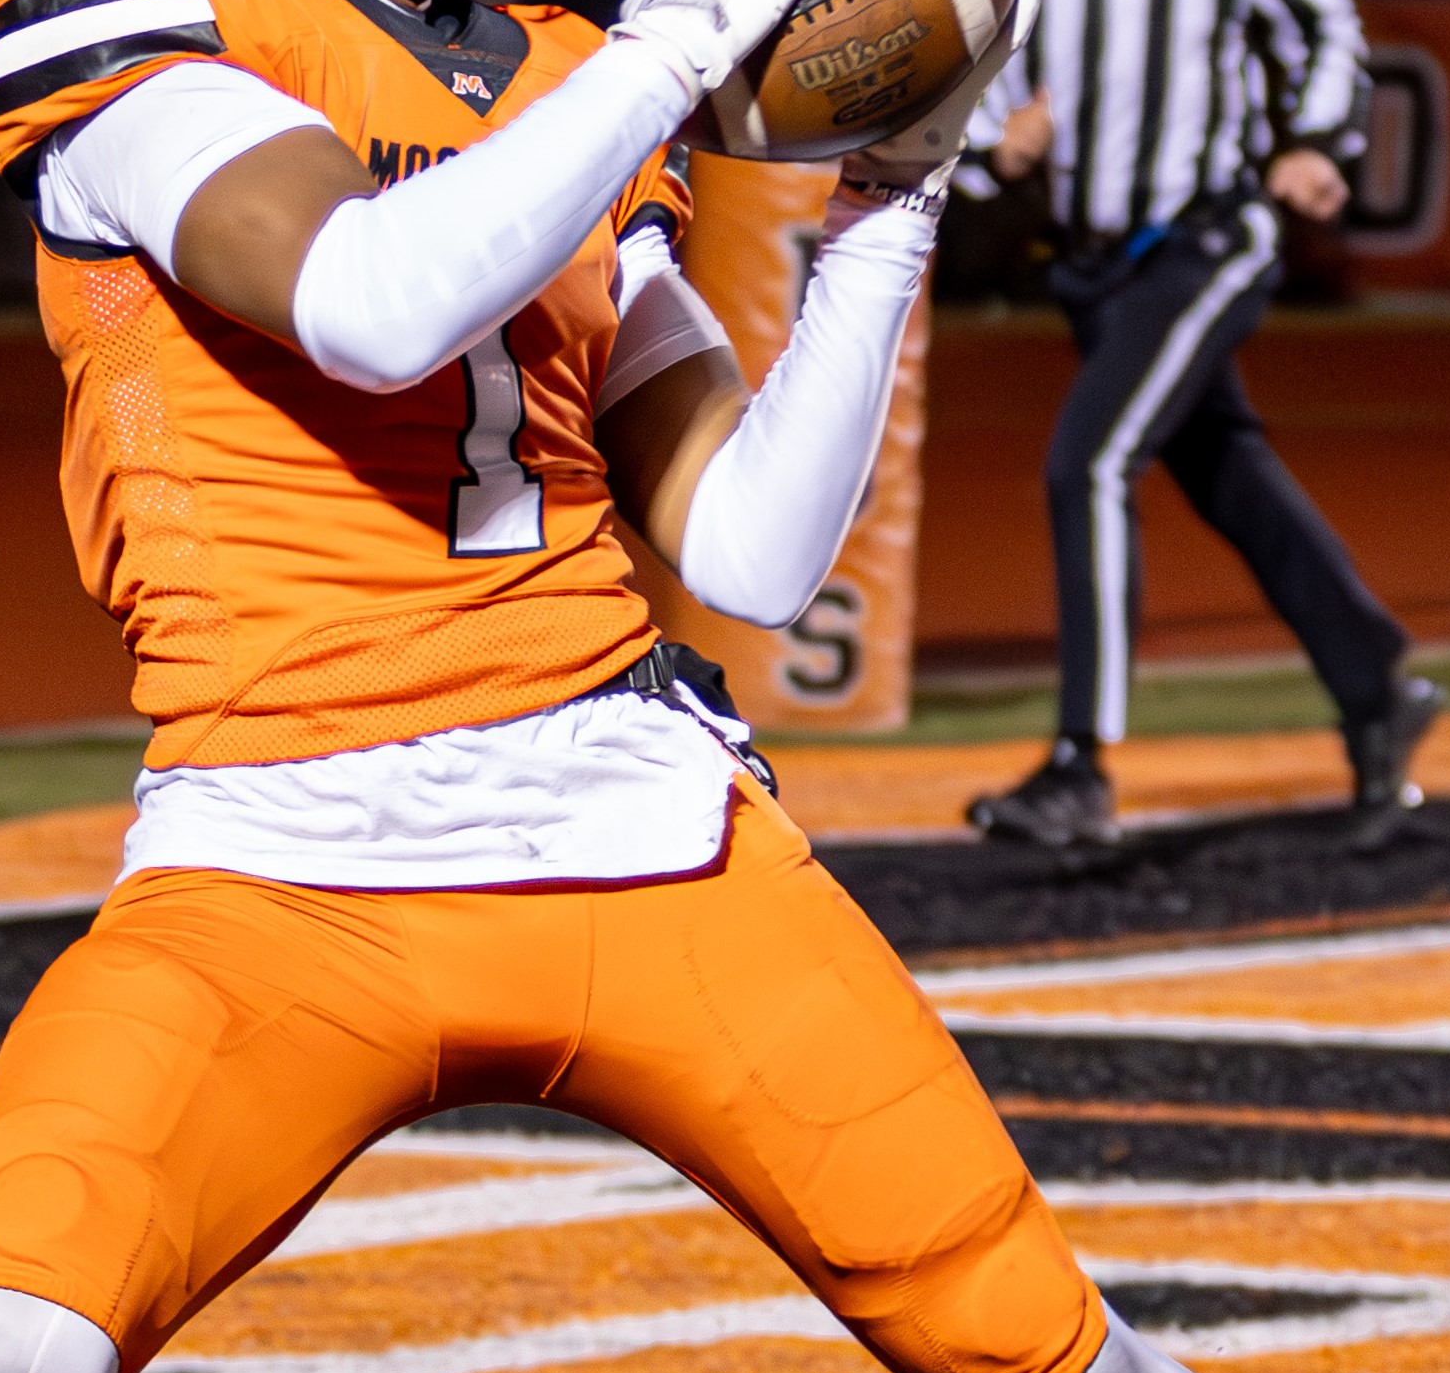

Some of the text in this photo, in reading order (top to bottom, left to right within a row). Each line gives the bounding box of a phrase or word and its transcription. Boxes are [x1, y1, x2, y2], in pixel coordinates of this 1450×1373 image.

[452, 71, 493, 100] M
[788, 17, 933, 91] Wilson
[447, 315, 548, 560] 1
